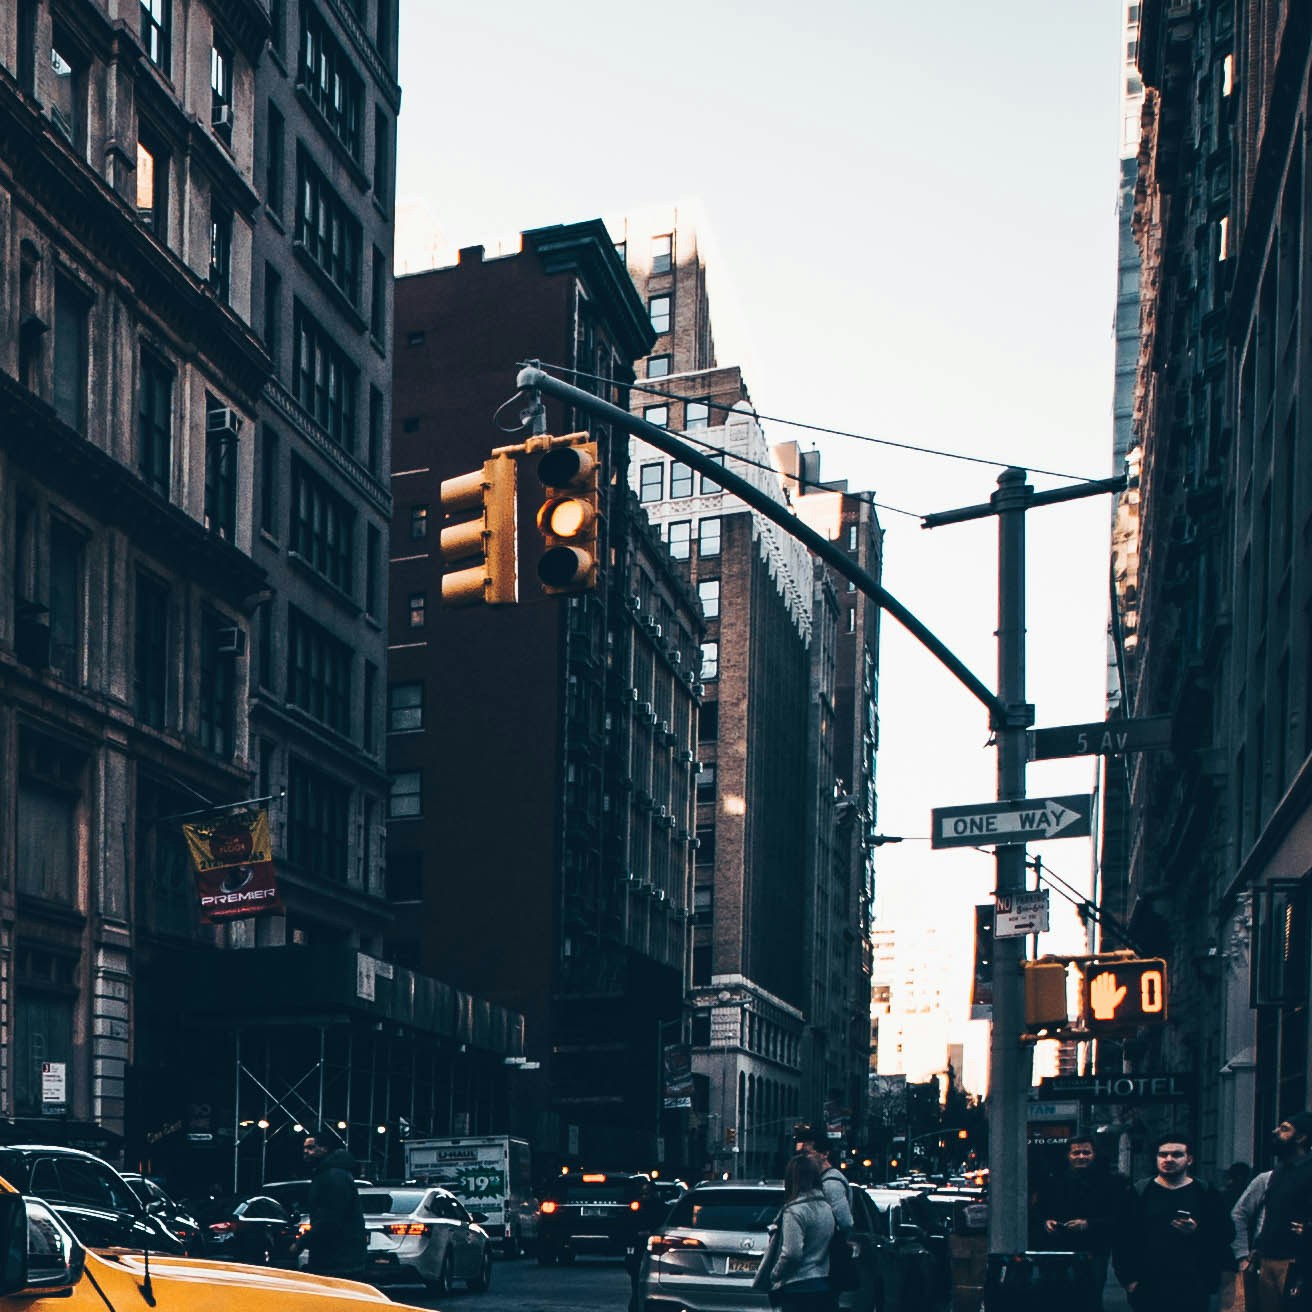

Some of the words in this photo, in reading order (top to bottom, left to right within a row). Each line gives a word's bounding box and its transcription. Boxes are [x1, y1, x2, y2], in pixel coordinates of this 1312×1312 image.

[1077, 732, 1088, 753] 5
[953, 816, 997, 835] ONE
[1019, 809, 1066, 830] WAY
[201, 888, 277, 905] PREMIER
[997, 894, 1011, 912] NO
[1140, 970, 1163, 1014] 0
[1094, 1078, 1185, 1097] HOTEL
